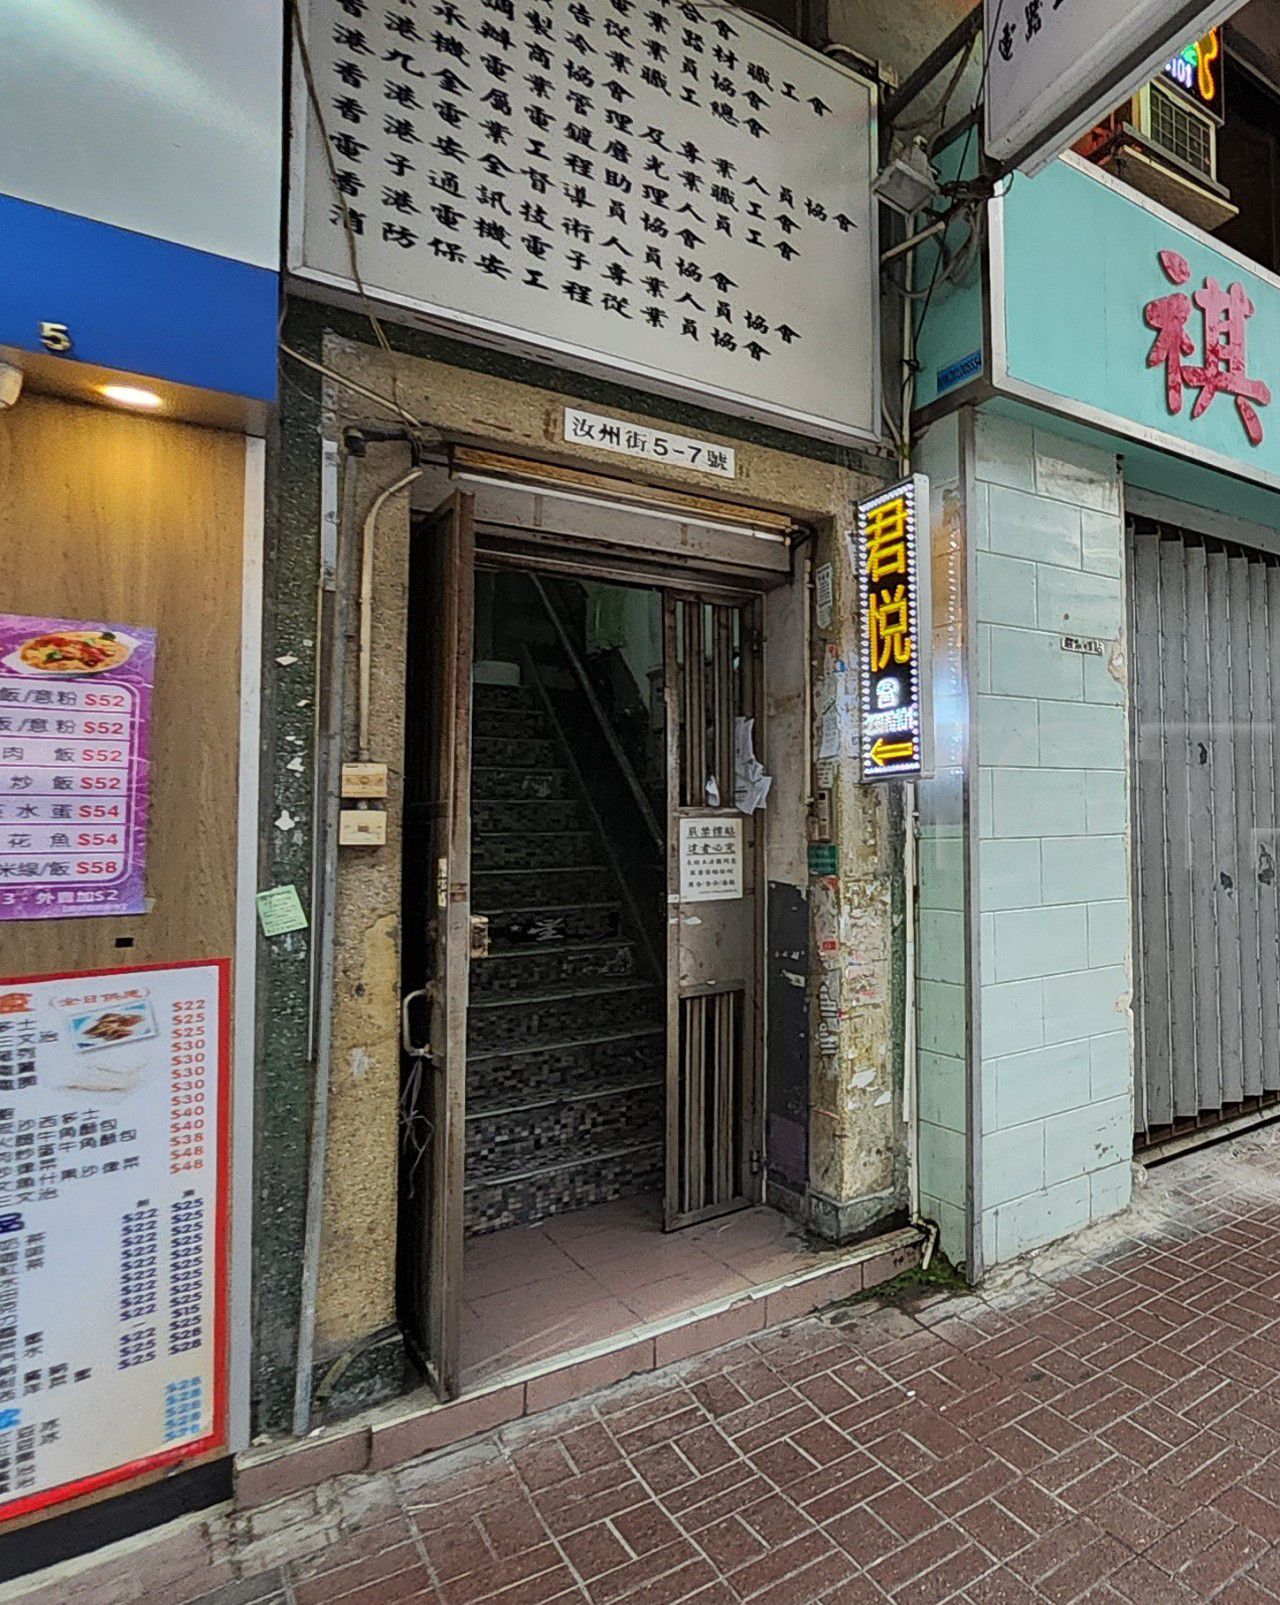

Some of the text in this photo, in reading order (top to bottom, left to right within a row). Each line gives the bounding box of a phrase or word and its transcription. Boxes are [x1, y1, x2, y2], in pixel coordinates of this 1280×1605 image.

[547, 1, 770, 111] 告從業員協會
[326, 131, 738, 294] 電子通訊技術人員協會
[331, 94, 706, 250] 香港安全督導員協會
[332, 58, 801, 262] 香港電業工程助理人員工會
[328, 195, 771, 362] 消防保安工程從業員協會
[331, 158, 802, 345] 香港電機電子專業人員協會
[39, 320, 71, 351] 5
[572, 415, 729, 471] 汝州街5-7號
